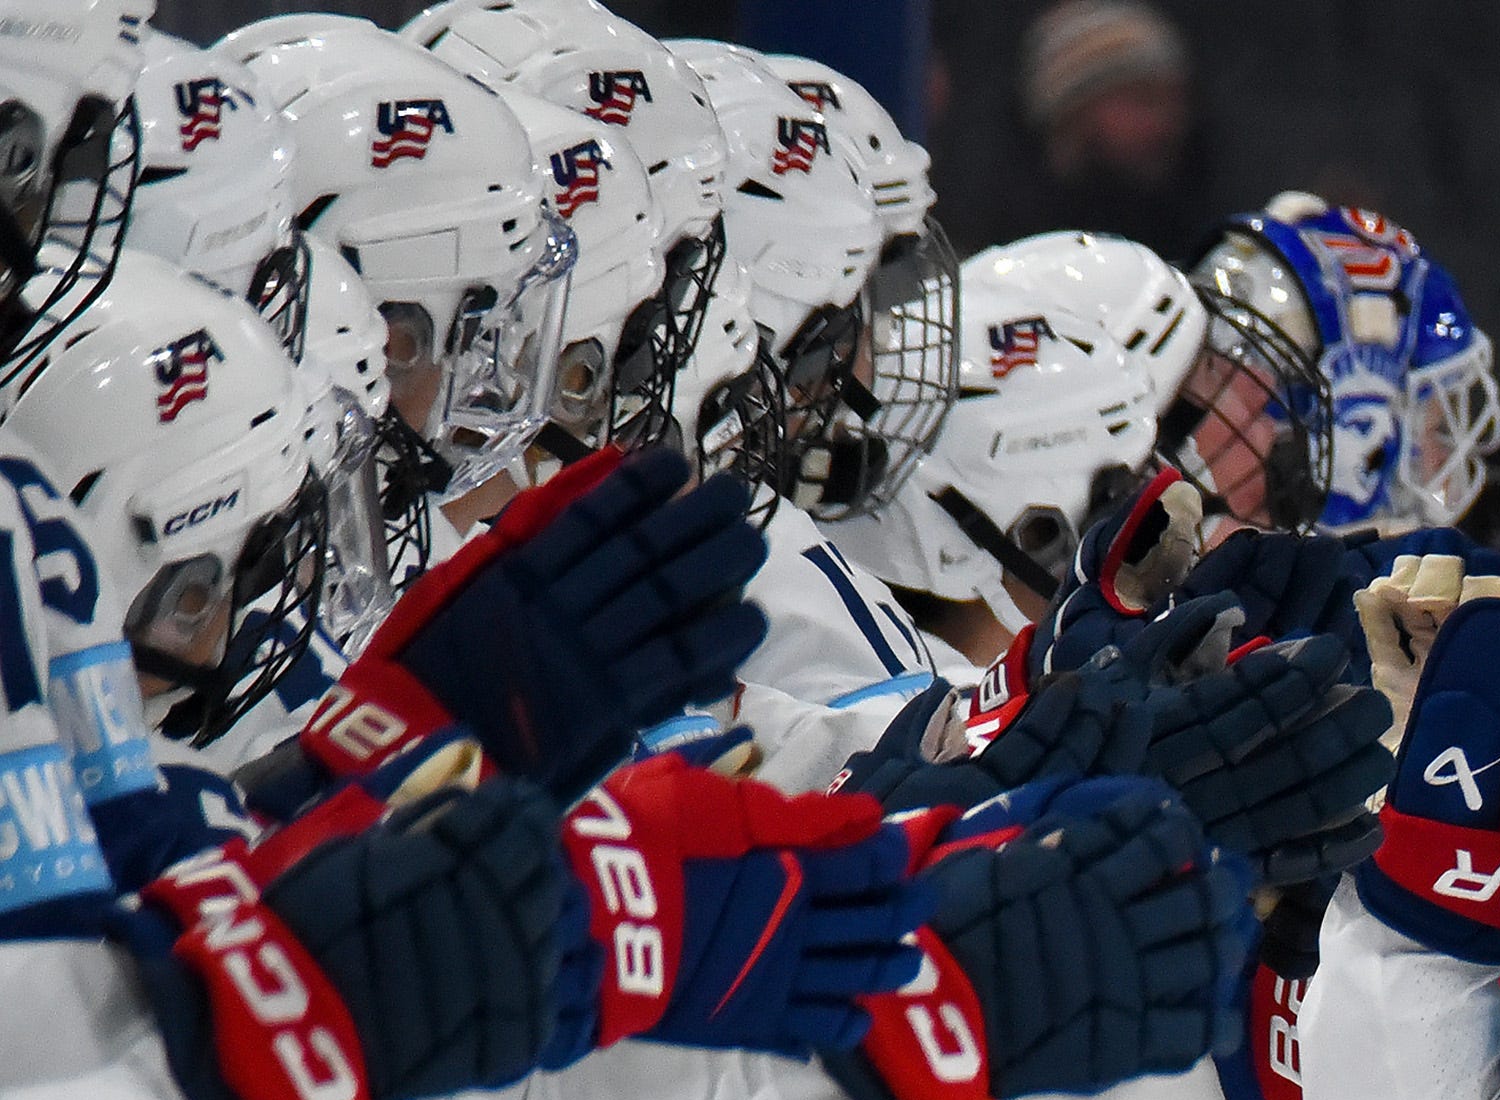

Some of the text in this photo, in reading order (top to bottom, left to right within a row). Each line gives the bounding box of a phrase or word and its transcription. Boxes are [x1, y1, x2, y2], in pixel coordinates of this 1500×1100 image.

[173, 77, 238, 152] USA
[586, 70, 653, 126] USA
[371, 99, 455, 168] USA
[772, 116, 831, 175] USA
[550, 139, 612, 219] USA
[154, 327, 226, 424] USA
[987, 315, 1057, 379] USA
[164, 490, 240, 536] CCM
